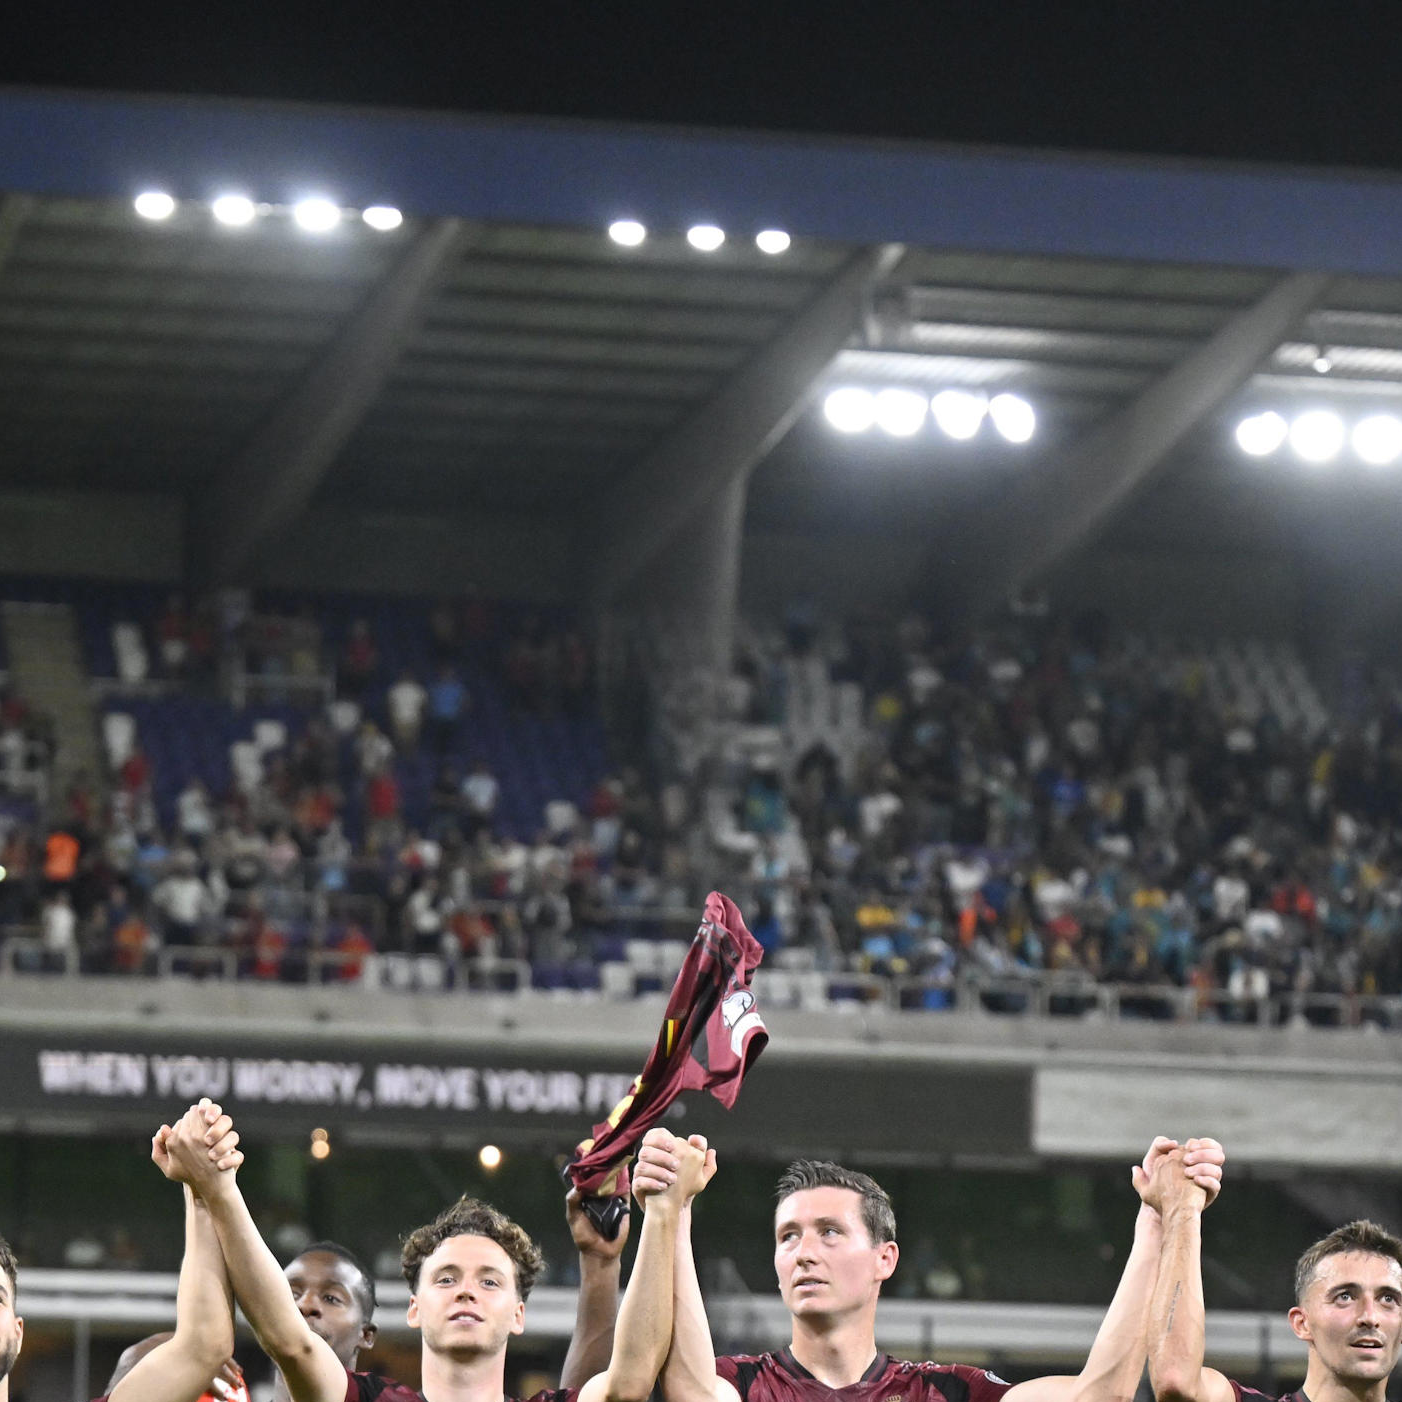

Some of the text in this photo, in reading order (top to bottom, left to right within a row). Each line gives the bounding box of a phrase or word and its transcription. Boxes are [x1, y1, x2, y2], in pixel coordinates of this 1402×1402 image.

[38, 1050, 149, 1095] WHEN
[152, 1055, 228, 1097] YOU
[234, 1059, 371, 1109] WORRY,
[376, 1064, 480, 1107] MOVE
[484, 1069, 584, 1114] YOUR
